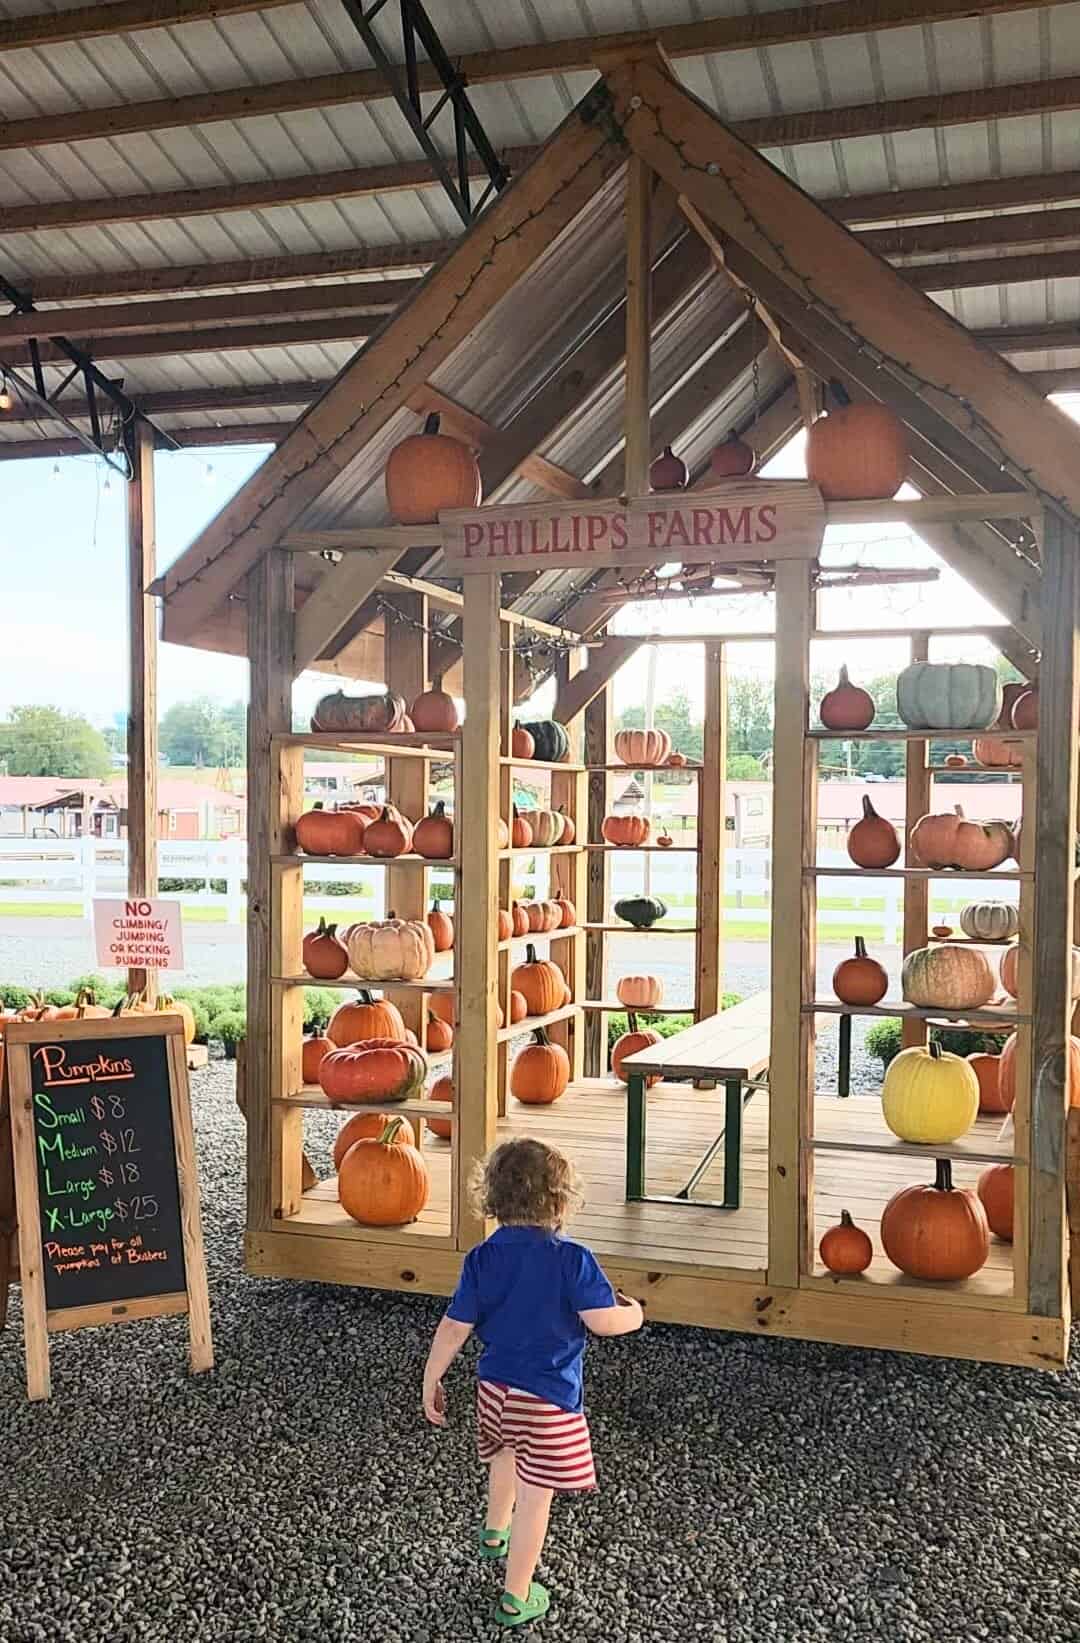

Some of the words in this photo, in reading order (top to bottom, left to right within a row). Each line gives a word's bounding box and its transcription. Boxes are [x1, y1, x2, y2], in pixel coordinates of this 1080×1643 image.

[463, 512, 629, 558] PHILLIPS
[647, 503, 778, 548] FARMS
[125, 901, 152, 917] NO
[112, 919, 169, 931] CLIMBING/
[116, 931, 164, 942] JUMPING
[110, 943, 125, 953] OR
[127, 944, 171, 955] KICKING
[115, 955, 169, 968] PUMPKINS
[33, 1045, 134, 1081] Pumpkins
[35, 1094, 86, 1128] Small
[38, 1133, 98, 1167] Medium
[99, 1129, 142, 1158] $12
[45, 1168, 97, 1201] Large
[45, 1207, 115, 1232] X-Large
[114, 1195, 159, 1222] $25
[44, 1241, 85, 1259] Please
[111, 1238, 125, 1249] for
[129, 1235, 143, 1247] all
[111, 1252, 122, 1264] at
